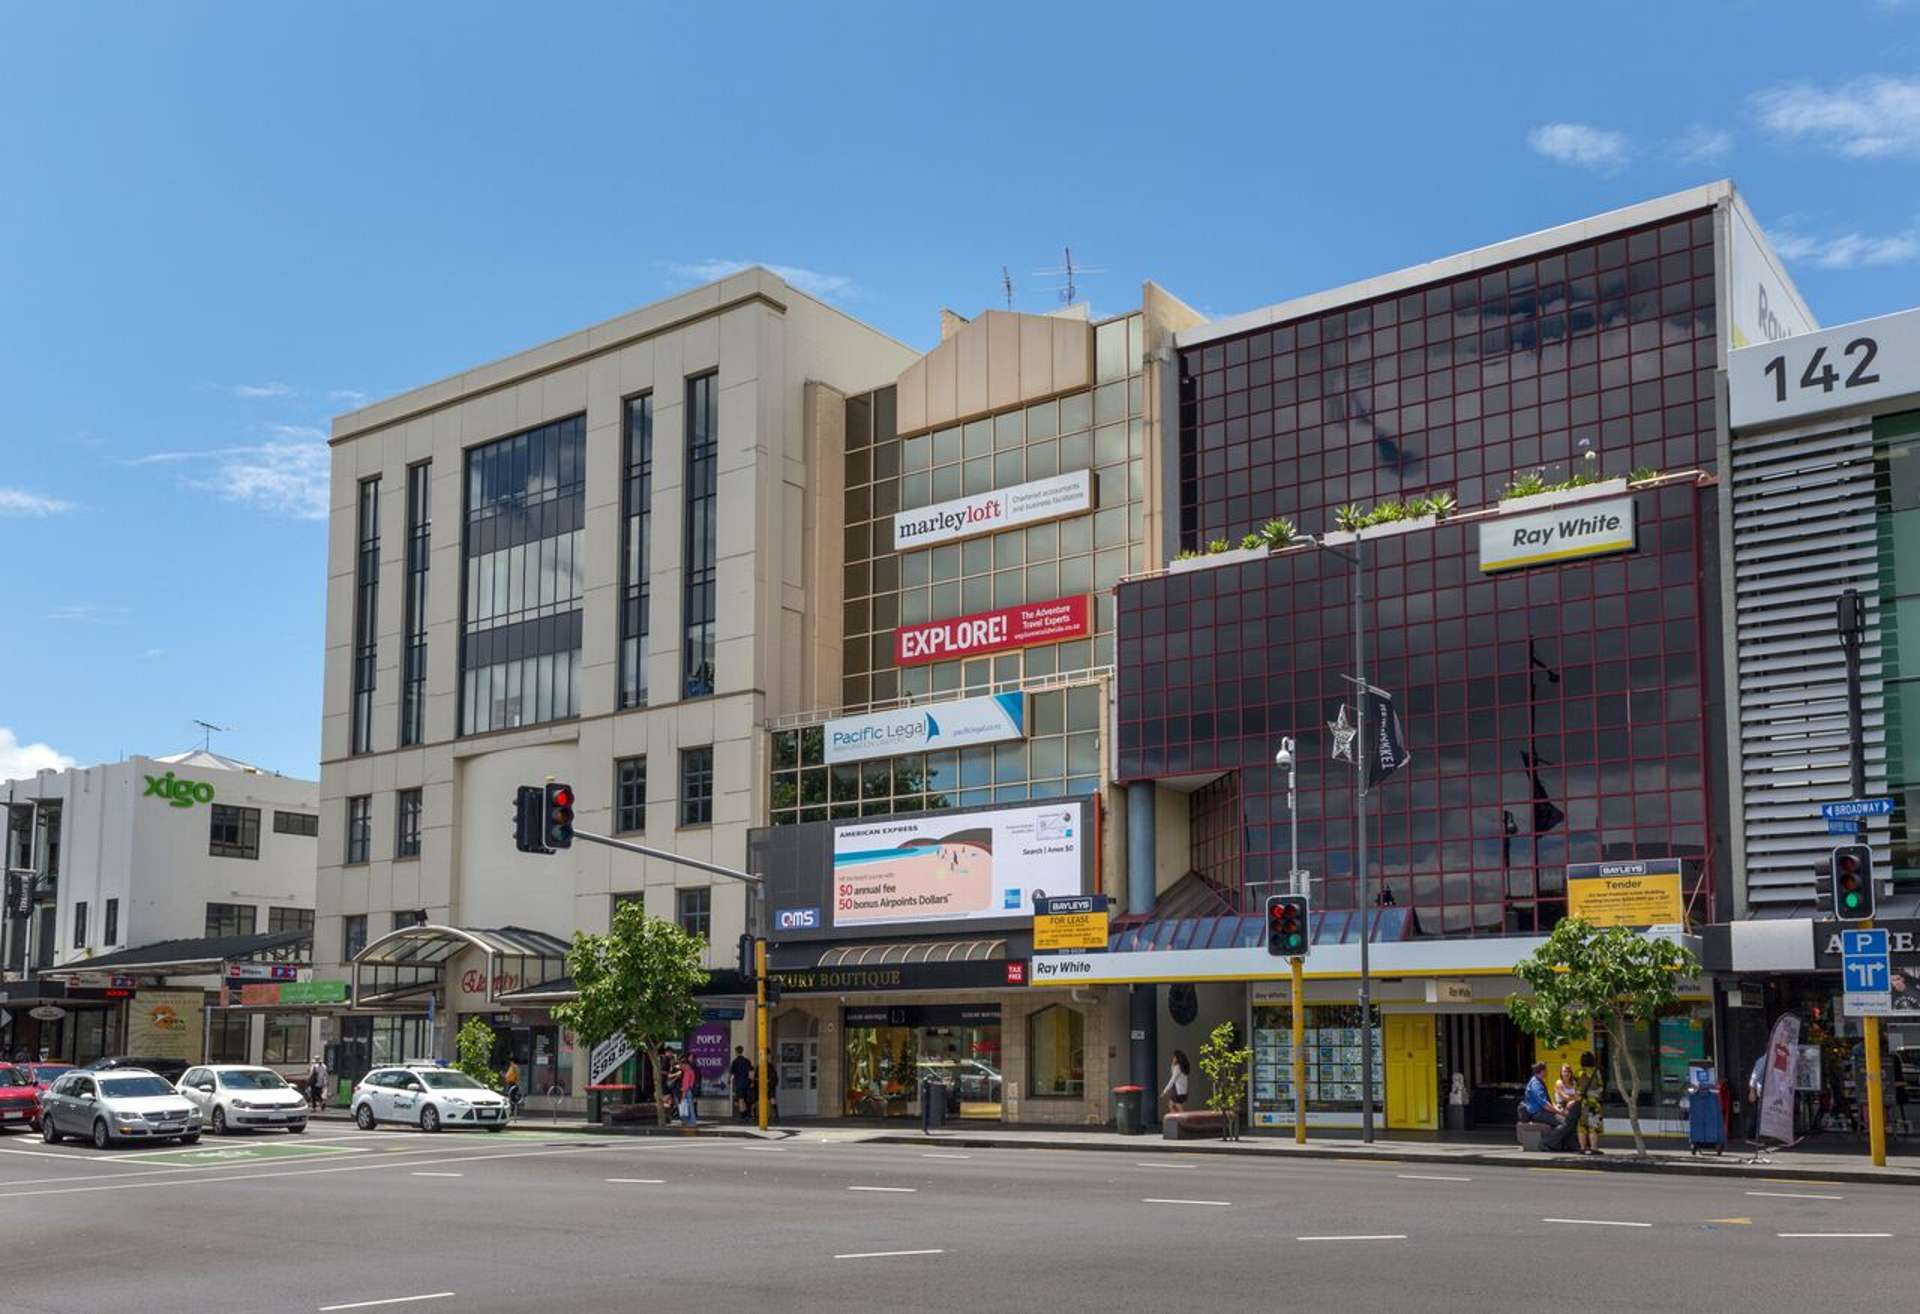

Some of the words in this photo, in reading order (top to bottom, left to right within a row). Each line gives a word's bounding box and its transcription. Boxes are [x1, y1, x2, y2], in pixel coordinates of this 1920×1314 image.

[1765, 337, 1880, 402] 142
[900, 500, 1001, 539] marleyloft
[1513, 526, 1555, 546] Ray
[1559, 515, 1620, 539] White
[1022, 610, 1034, 620] The
[1035, 604, 1071, 617] Adventure
[1023, 620, 1043, 630] Travel
[1044, 615, 1071, 627] Experts
[902, 615, 1008, 658] EXPLORE!
[833, 727, 884, 745] Pacific
[887, 719, 926, 739] Legal
[144, 771, 215, 808] xigo
[1834, 801, 1880, 816] BROADWAY
[840, 829, 880, 838] AMERICAN
[883, 825, 918, 834] EXPRESS
[840, 884, 853, 896] $0
[854, 884, 880, 895] annual
[882, 882, 896, 893] fee
[1605, 880, 1642, 889] Tender
[839, 898, 853, 910] 50
[853, 898, 879, 909] bonus
[880, 896, 918, 908] Airpoints
[781, 910, 814, 927] QMS
[1857, 934, 1873, 952] P
[1037, 962, 1058, 975] Ray
[1060, 962, 1091, 973] White
[820, 970, 900, 989] BOUTIQUE
[697, 1035, 722, 1045] POPUP
[697, 1057, 722, 1067] STORE
